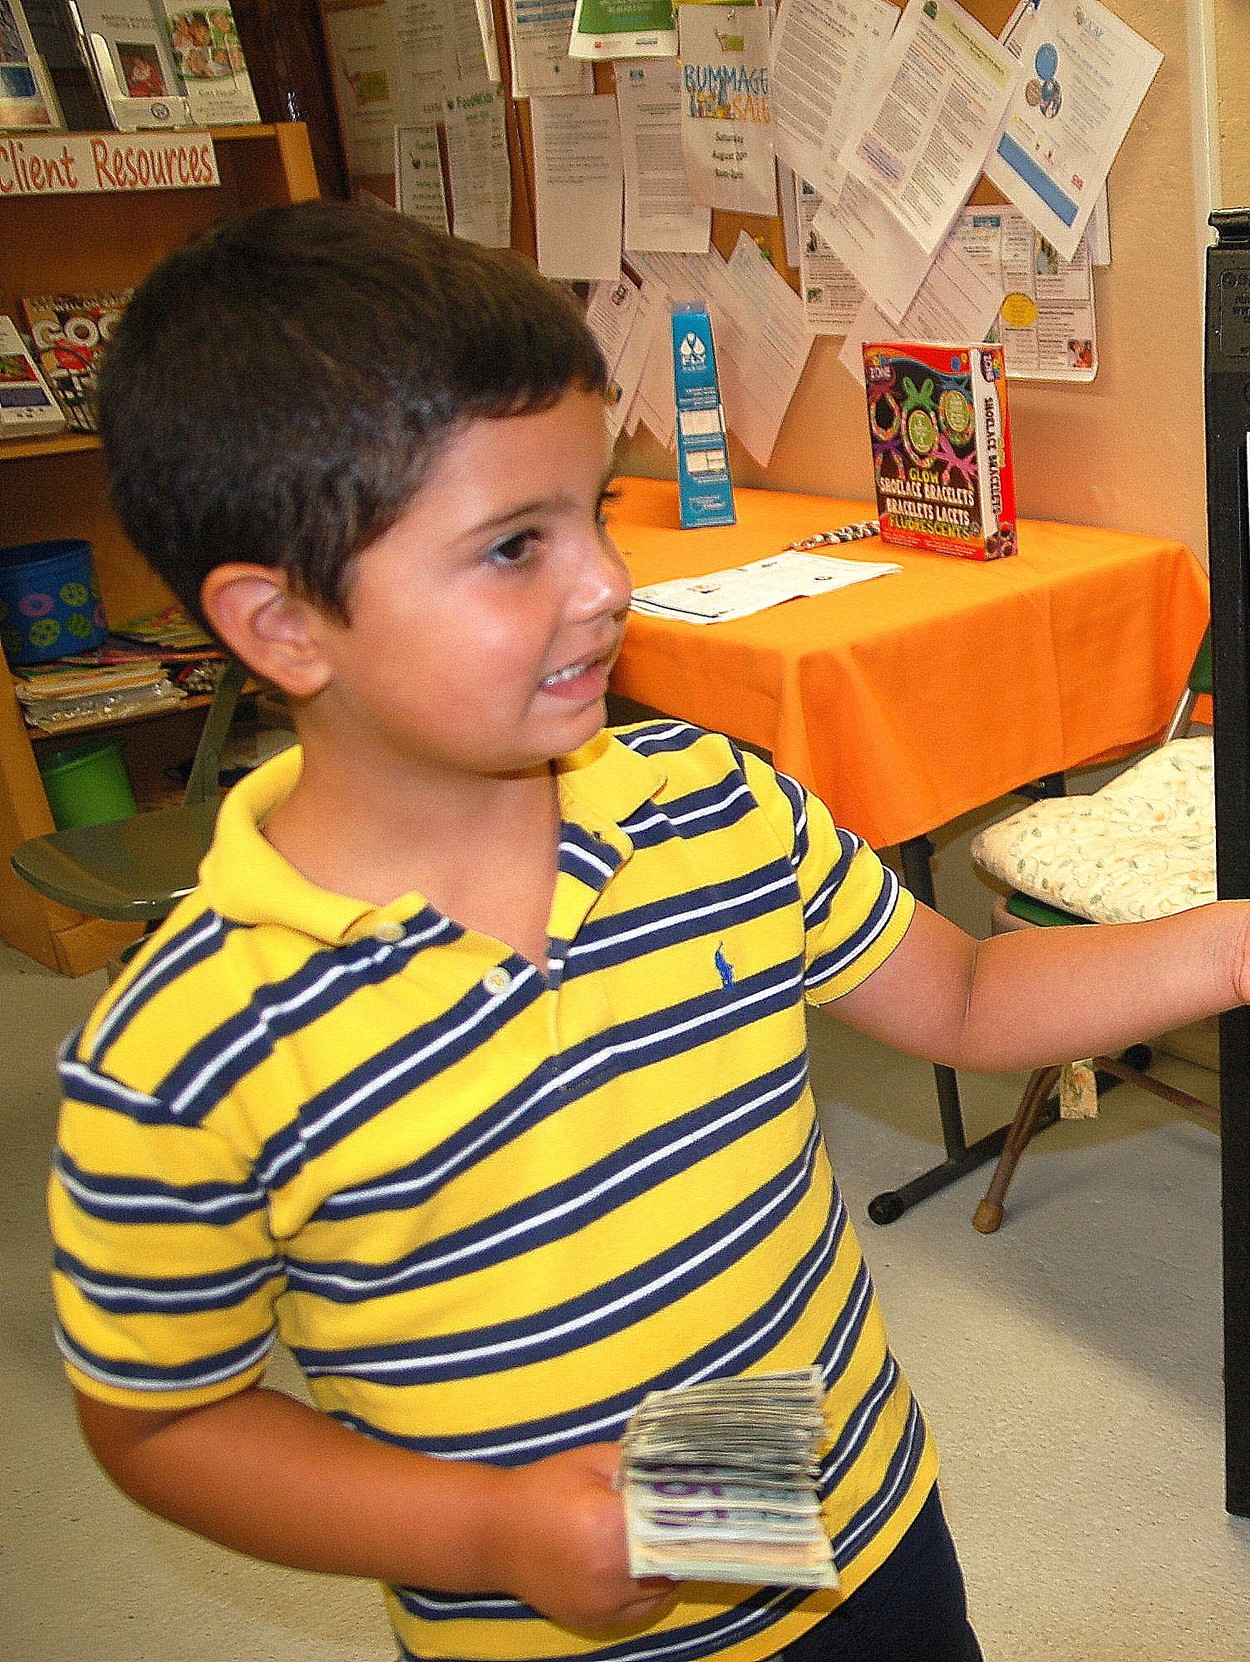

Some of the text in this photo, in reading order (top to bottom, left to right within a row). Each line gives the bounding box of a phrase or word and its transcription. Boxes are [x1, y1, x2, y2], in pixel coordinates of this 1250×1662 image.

[684, 64, 768, 95] RUMMAGE
[733, 93, 772, 125] SALE
[0, 138, 213, 192] Client Resources
[985, 397, 1001, 516] SHOELACE BRACELETS
[909, 467, 940, 483] GLOW
[879, 476, 975, 506] SHOELACE BRACELETS
[886, 497, 970, 527] BRACELETS LACETS
[889, 514, 970, 541] FLUORESCENTS
